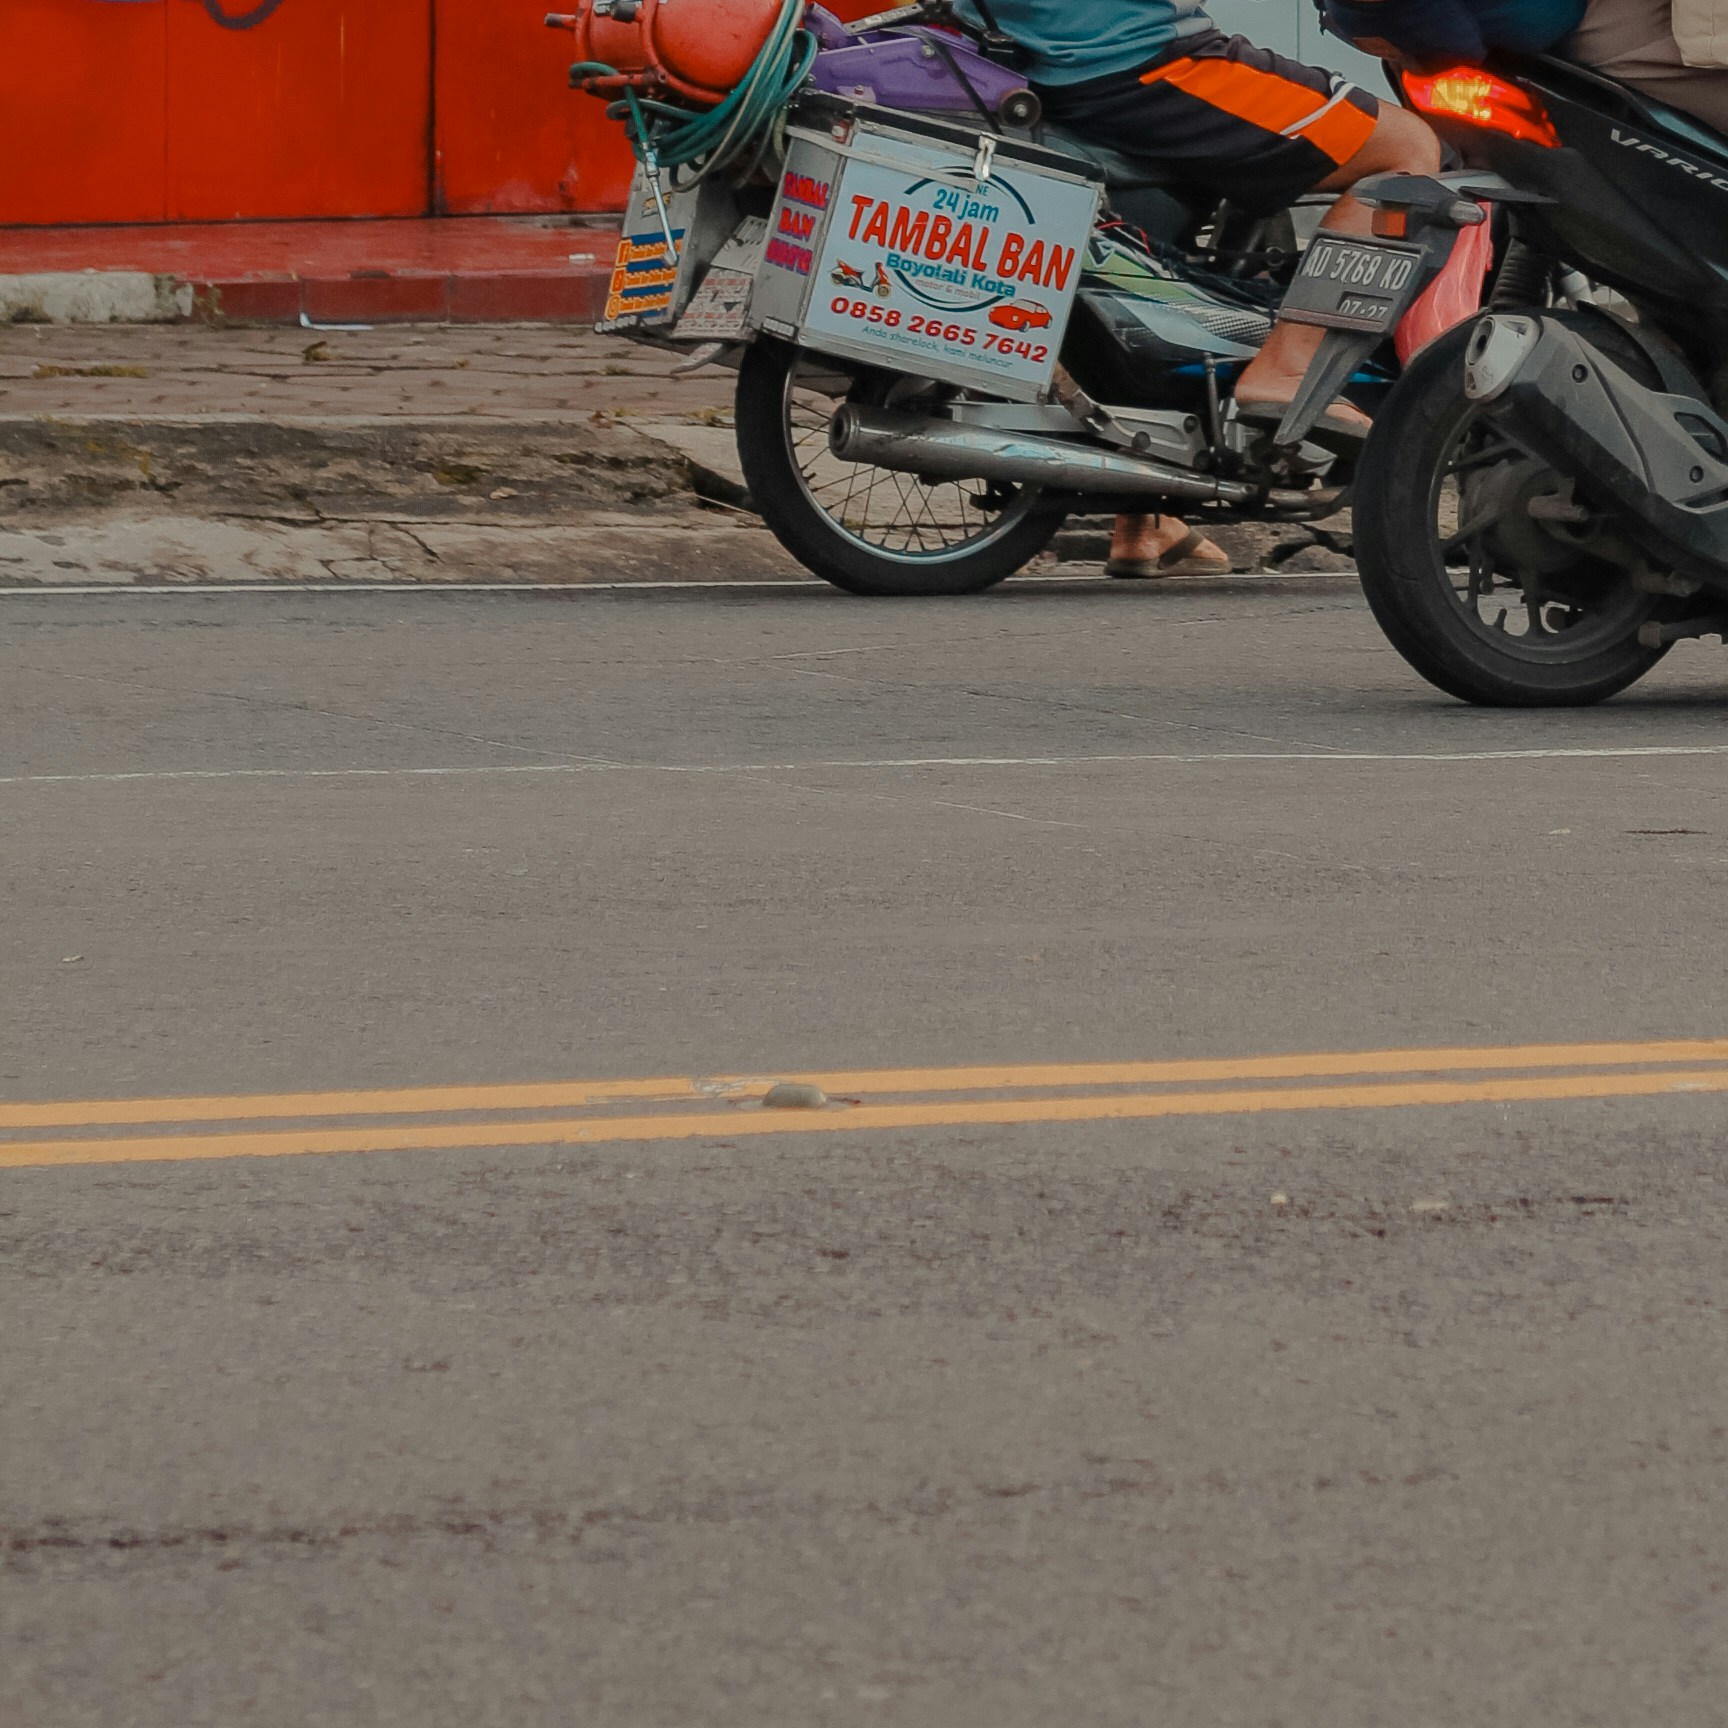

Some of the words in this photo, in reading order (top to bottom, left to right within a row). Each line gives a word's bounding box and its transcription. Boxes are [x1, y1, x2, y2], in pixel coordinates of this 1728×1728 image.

[933, 188, 959, 213] 24
[957, 194, 999, 223] jam
[848, 194, 990, 273] TAMBAL
[996, 232, 1076, 292] BAN
[886, 252, 967, 286] Boyolali
[971, 273, 1017, 297] Kota
[1301, 246, 1333, 277] AD
[1330, 249, 1382, 286] 5768
[1379, 258, 1412, 290] KD
[831, 297, 902, 327] 0858
[907, 315, 977, 345] 2665
[982, 333, 1048, 363] 7642
[862, 325, 887, 339] Anda
[943, 343, 966, 357] kami
